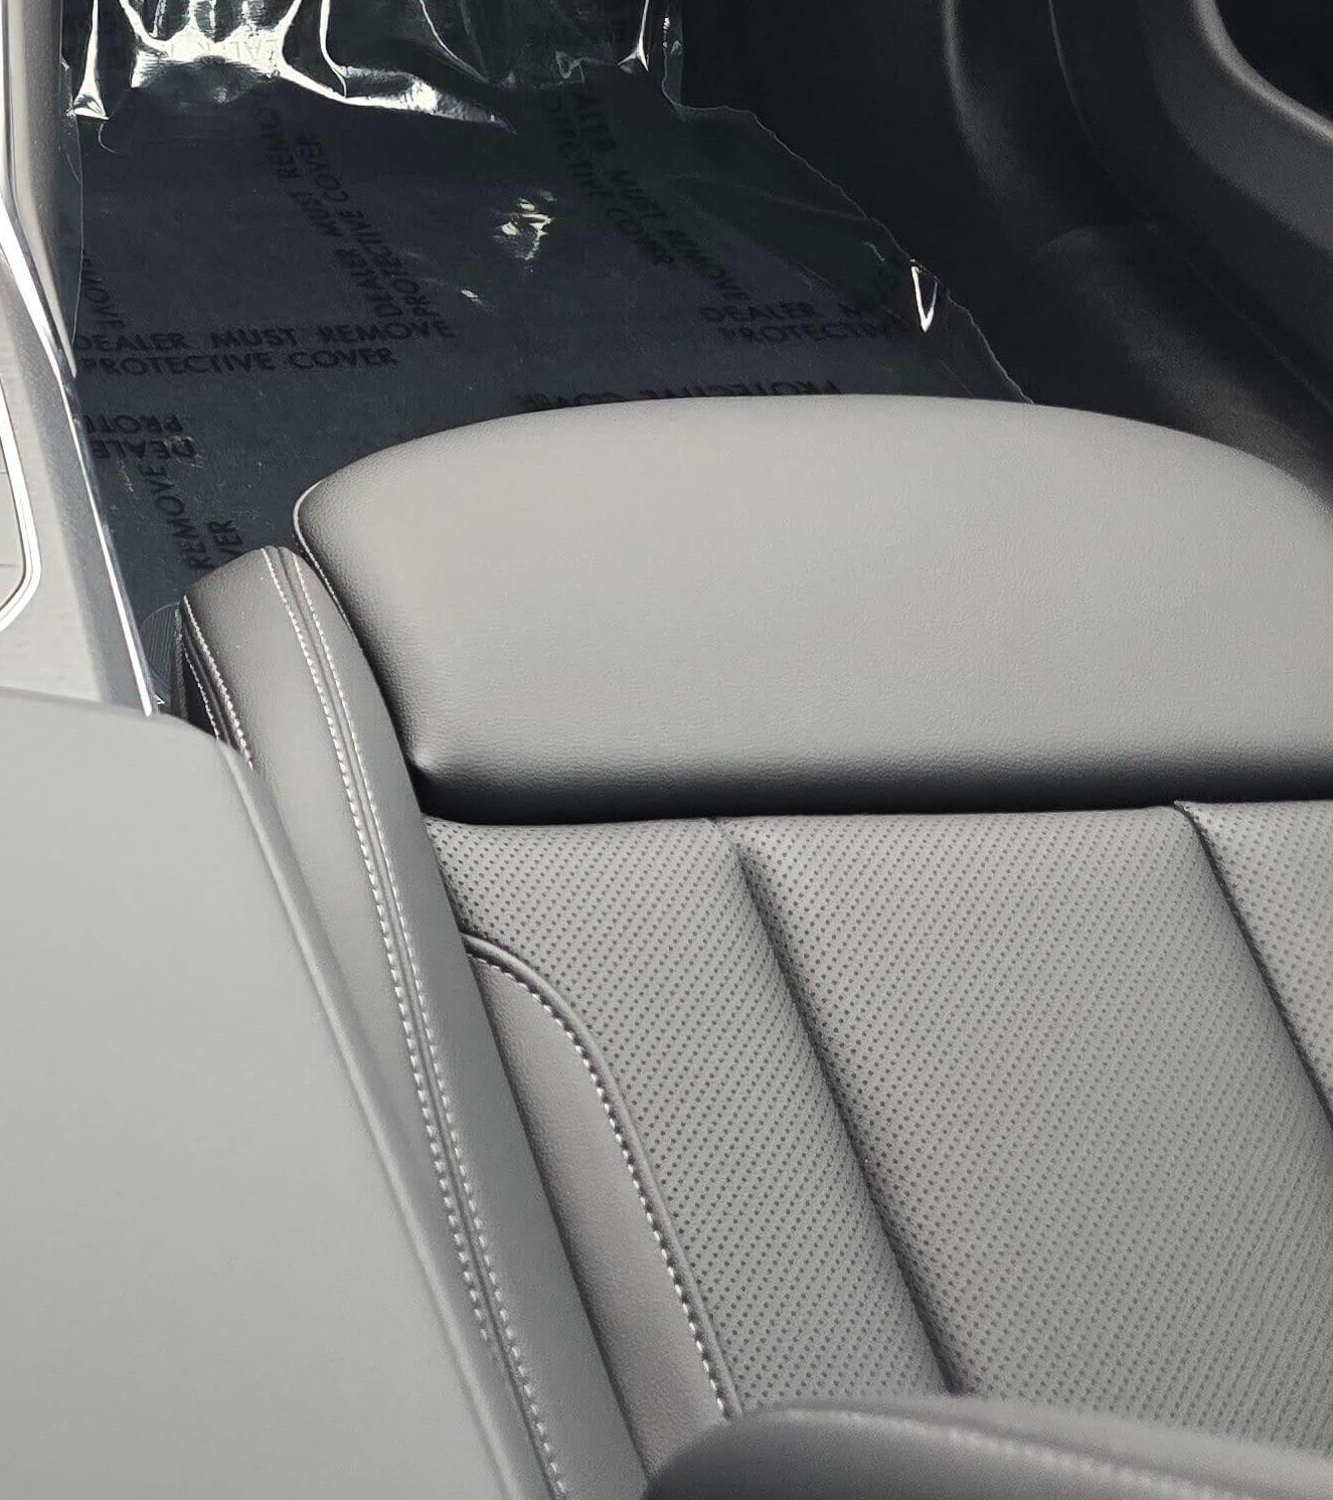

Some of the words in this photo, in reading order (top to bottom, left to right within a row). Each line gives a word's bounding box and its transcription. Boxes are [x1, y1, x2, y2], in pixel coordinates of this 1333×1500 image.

[74, 332, 186, 352] DEALER
[210, 328, 298, 349] MUST
[316, 319, 457, 345] REMOVE
[82, 352, 277, 376] PROTECTIVE
[287, 347, 399, 369] COVER
